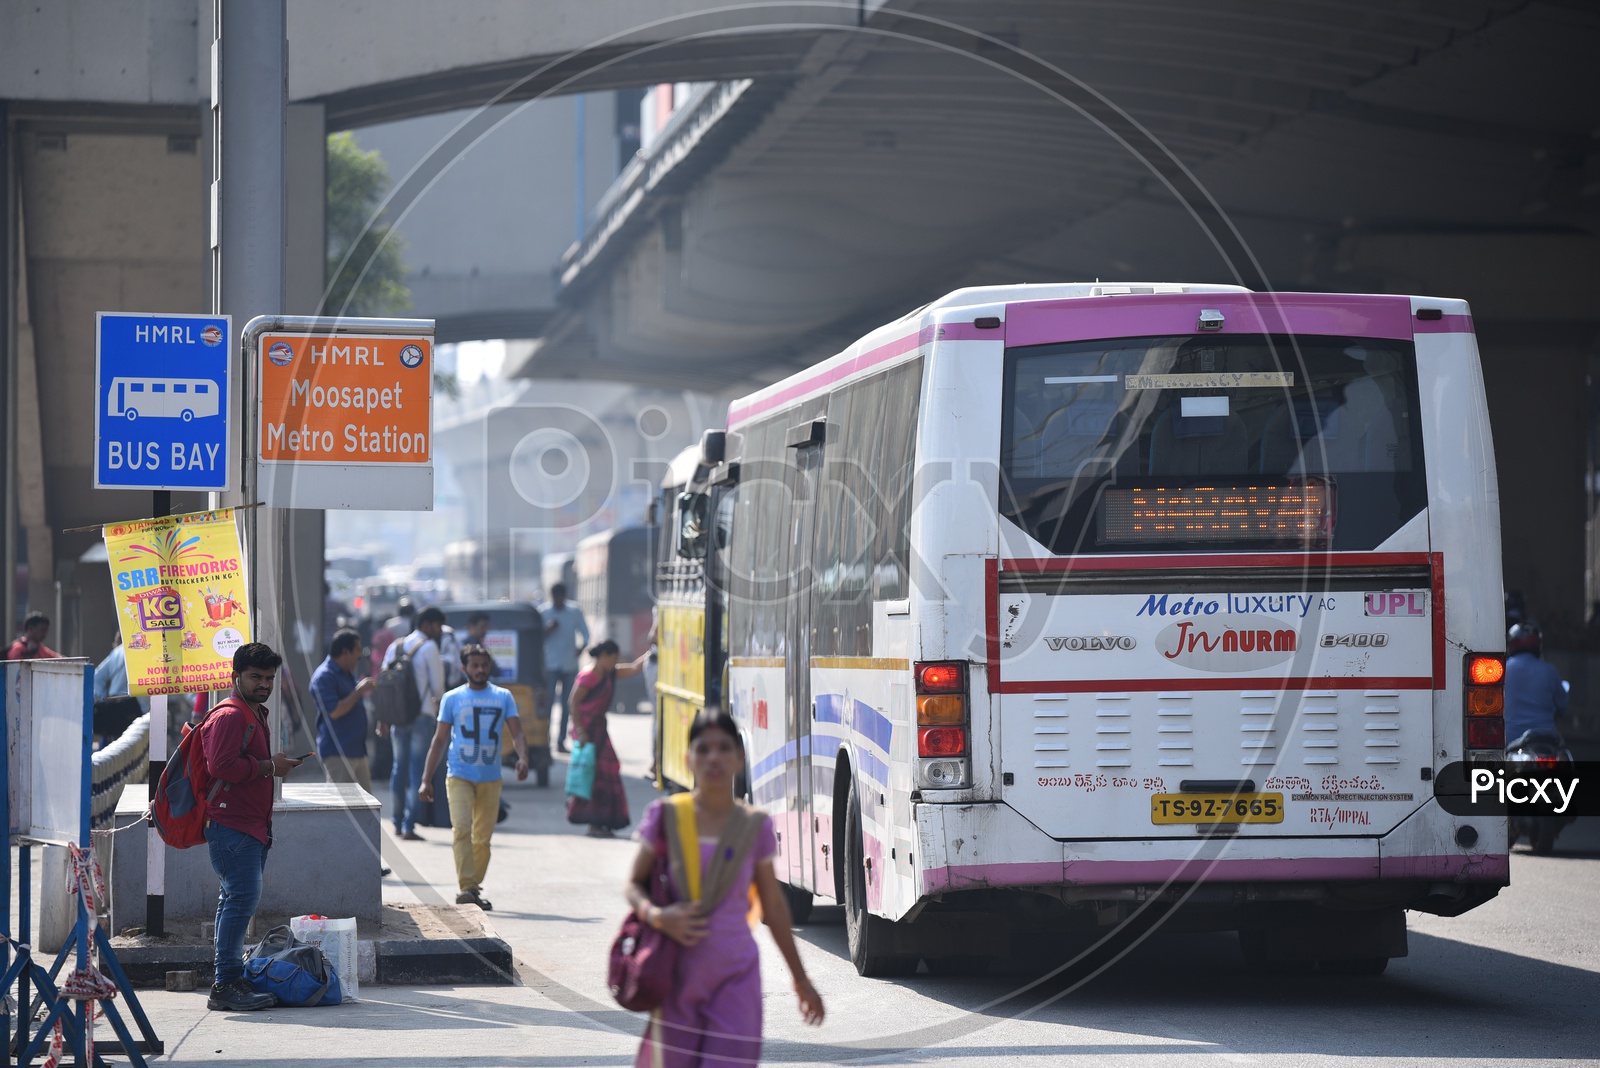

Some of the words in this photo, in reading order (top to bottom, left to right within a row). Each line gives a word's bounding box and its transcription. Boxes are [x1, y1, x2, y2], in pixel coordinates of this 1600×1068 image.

[135, 324, 195, 345] HMRL
[311, 345, 385, 366] HMRL
[291, 378, 403, 414] Moosapet
[267, 422, 334, 452] Metro
[344, 423, 426, 454] Station
[108, 440, 160, 471] BUS
[171, 442, 220, 471] BAY
[117, 567, 159, 591] SRR
[159, 558, 239, 578] FIREWORKS
[175, 576, 209, 585] CRACKERS
[139, 587, 170, 599] DIWALI
[142, 596, 180, 618] KG
[1136, 594, 1219, 617] Metro
[1227, 593, 1314, 618] luxury
[1318, 598, 1336, 611] AC
[1367, 594, 1424, 615] UPL
[150, 619, 176, 627] SALE
[1043, 636, 1137, 651] VOLVO
[1320, 633, 1389, 647] 8400
[147, 666, 169, 675] NOW
[172, 665, 179, 674] @
[181, 661, 233, 672] MOOSAPET
[138, 676, 172, 686] BESIDE
[175, 673, 216, 684] ANDHRA
[147, 685, 180, 696] GOODS
[183, 683, 210, 693] SHED
[1357, 793, 1389, 801] INJECTION
[1389, 793, 1413, 801] SYSTEM
[1159, 799, 1277, 817] TS-9Z-7665
